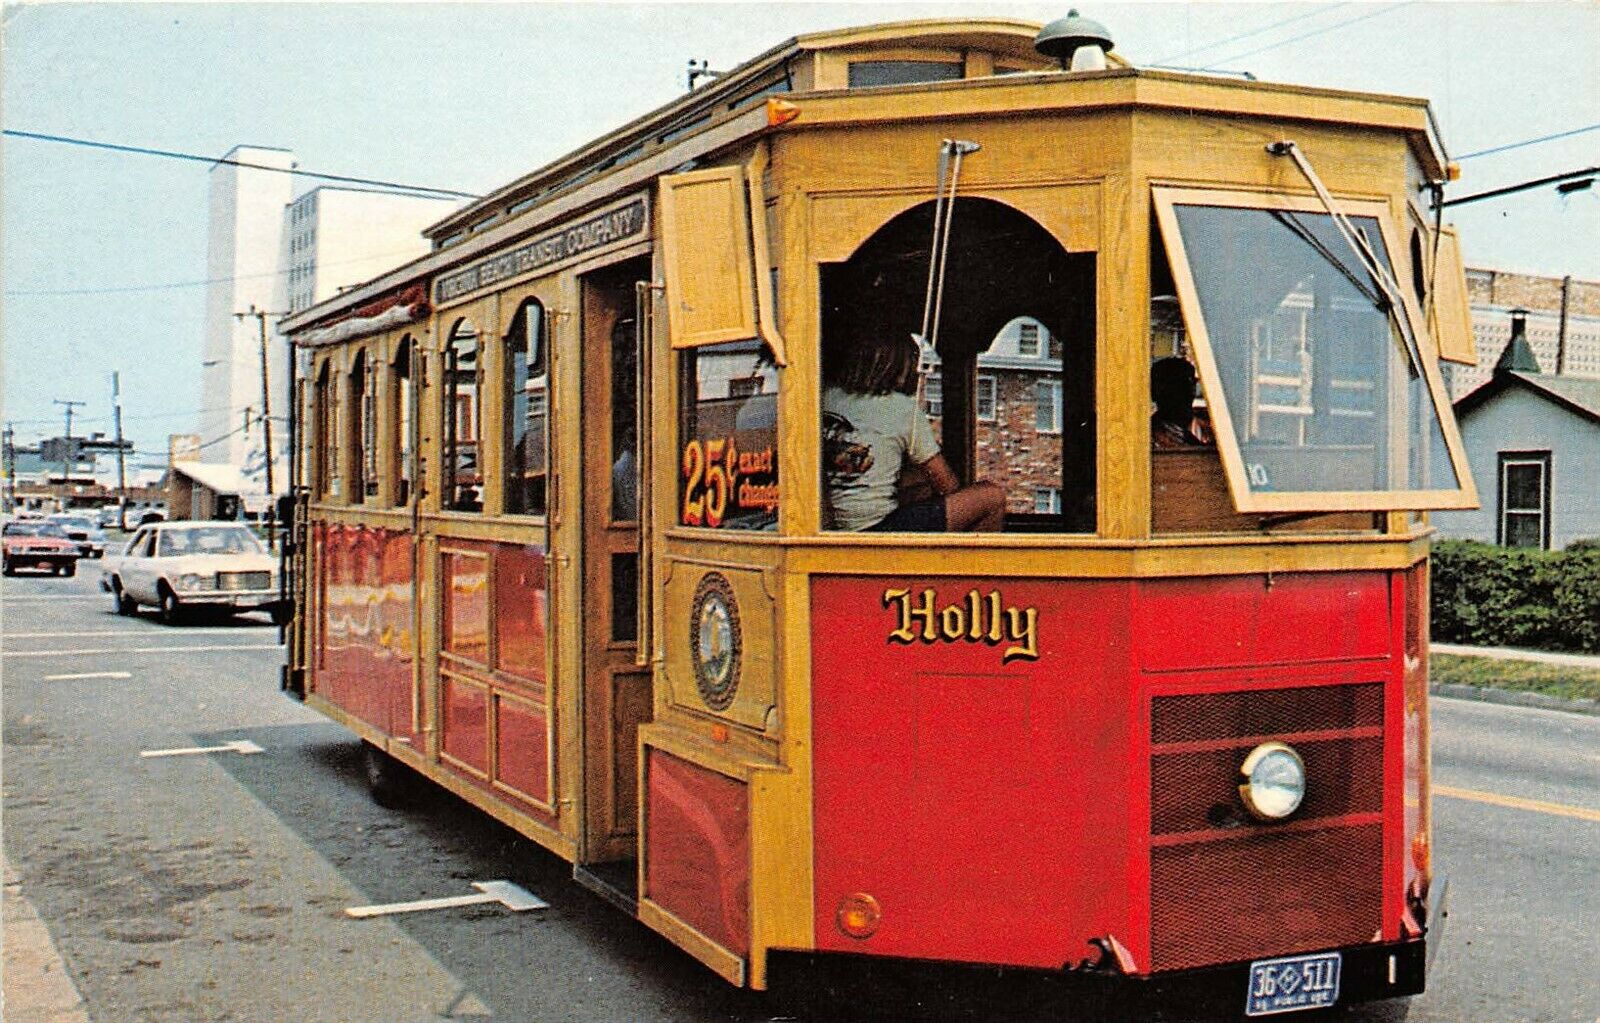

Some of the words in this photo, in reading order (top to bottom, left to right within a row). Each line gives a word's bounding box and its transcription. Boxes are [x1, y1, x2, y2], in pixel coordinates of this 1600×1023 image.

[515, 242, 564, 273] TRANSIT
[567, 208, 633, 252] COMPANY
[883, 587, 1040, 664] Holly
[1253, 966, 1276, 997] 36
[1303, 960, 1335, 991] 511
